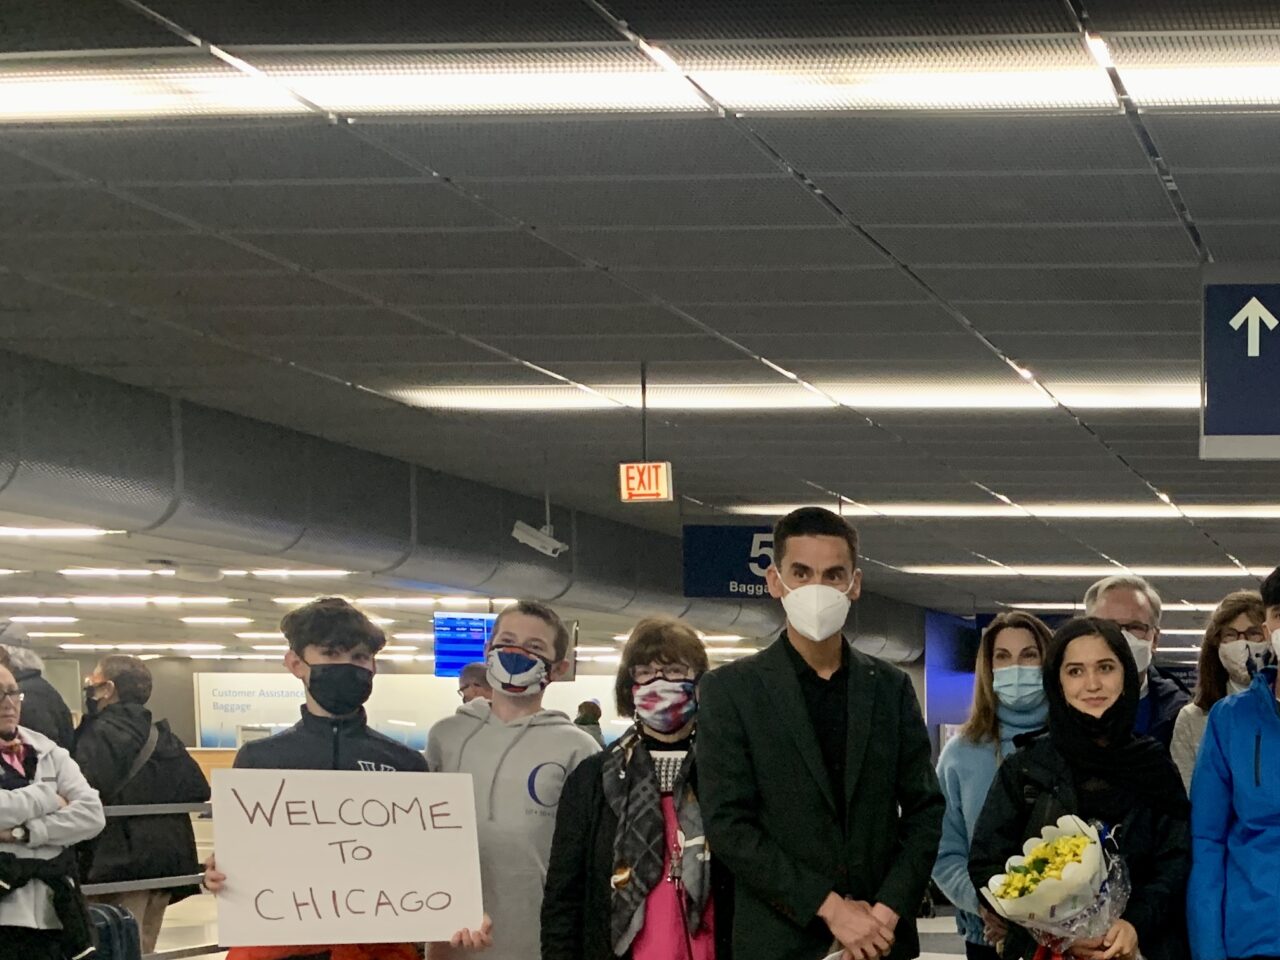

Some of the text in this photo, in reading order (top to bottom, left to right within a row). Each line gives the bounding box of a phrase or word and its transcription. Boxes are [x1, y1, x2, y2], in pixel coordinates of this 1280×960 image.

[626, 465, 661, 491] EXIT
[749, 533, 774, 577] 5
[729, 581, 769, 594] Bagga
[212, 688, 256, 698] Customer
[212, 702, 251, 713] Baggage
[231, 778, 463, 832] WELCOME
[254, 887, 452, 921] CHICAGO
